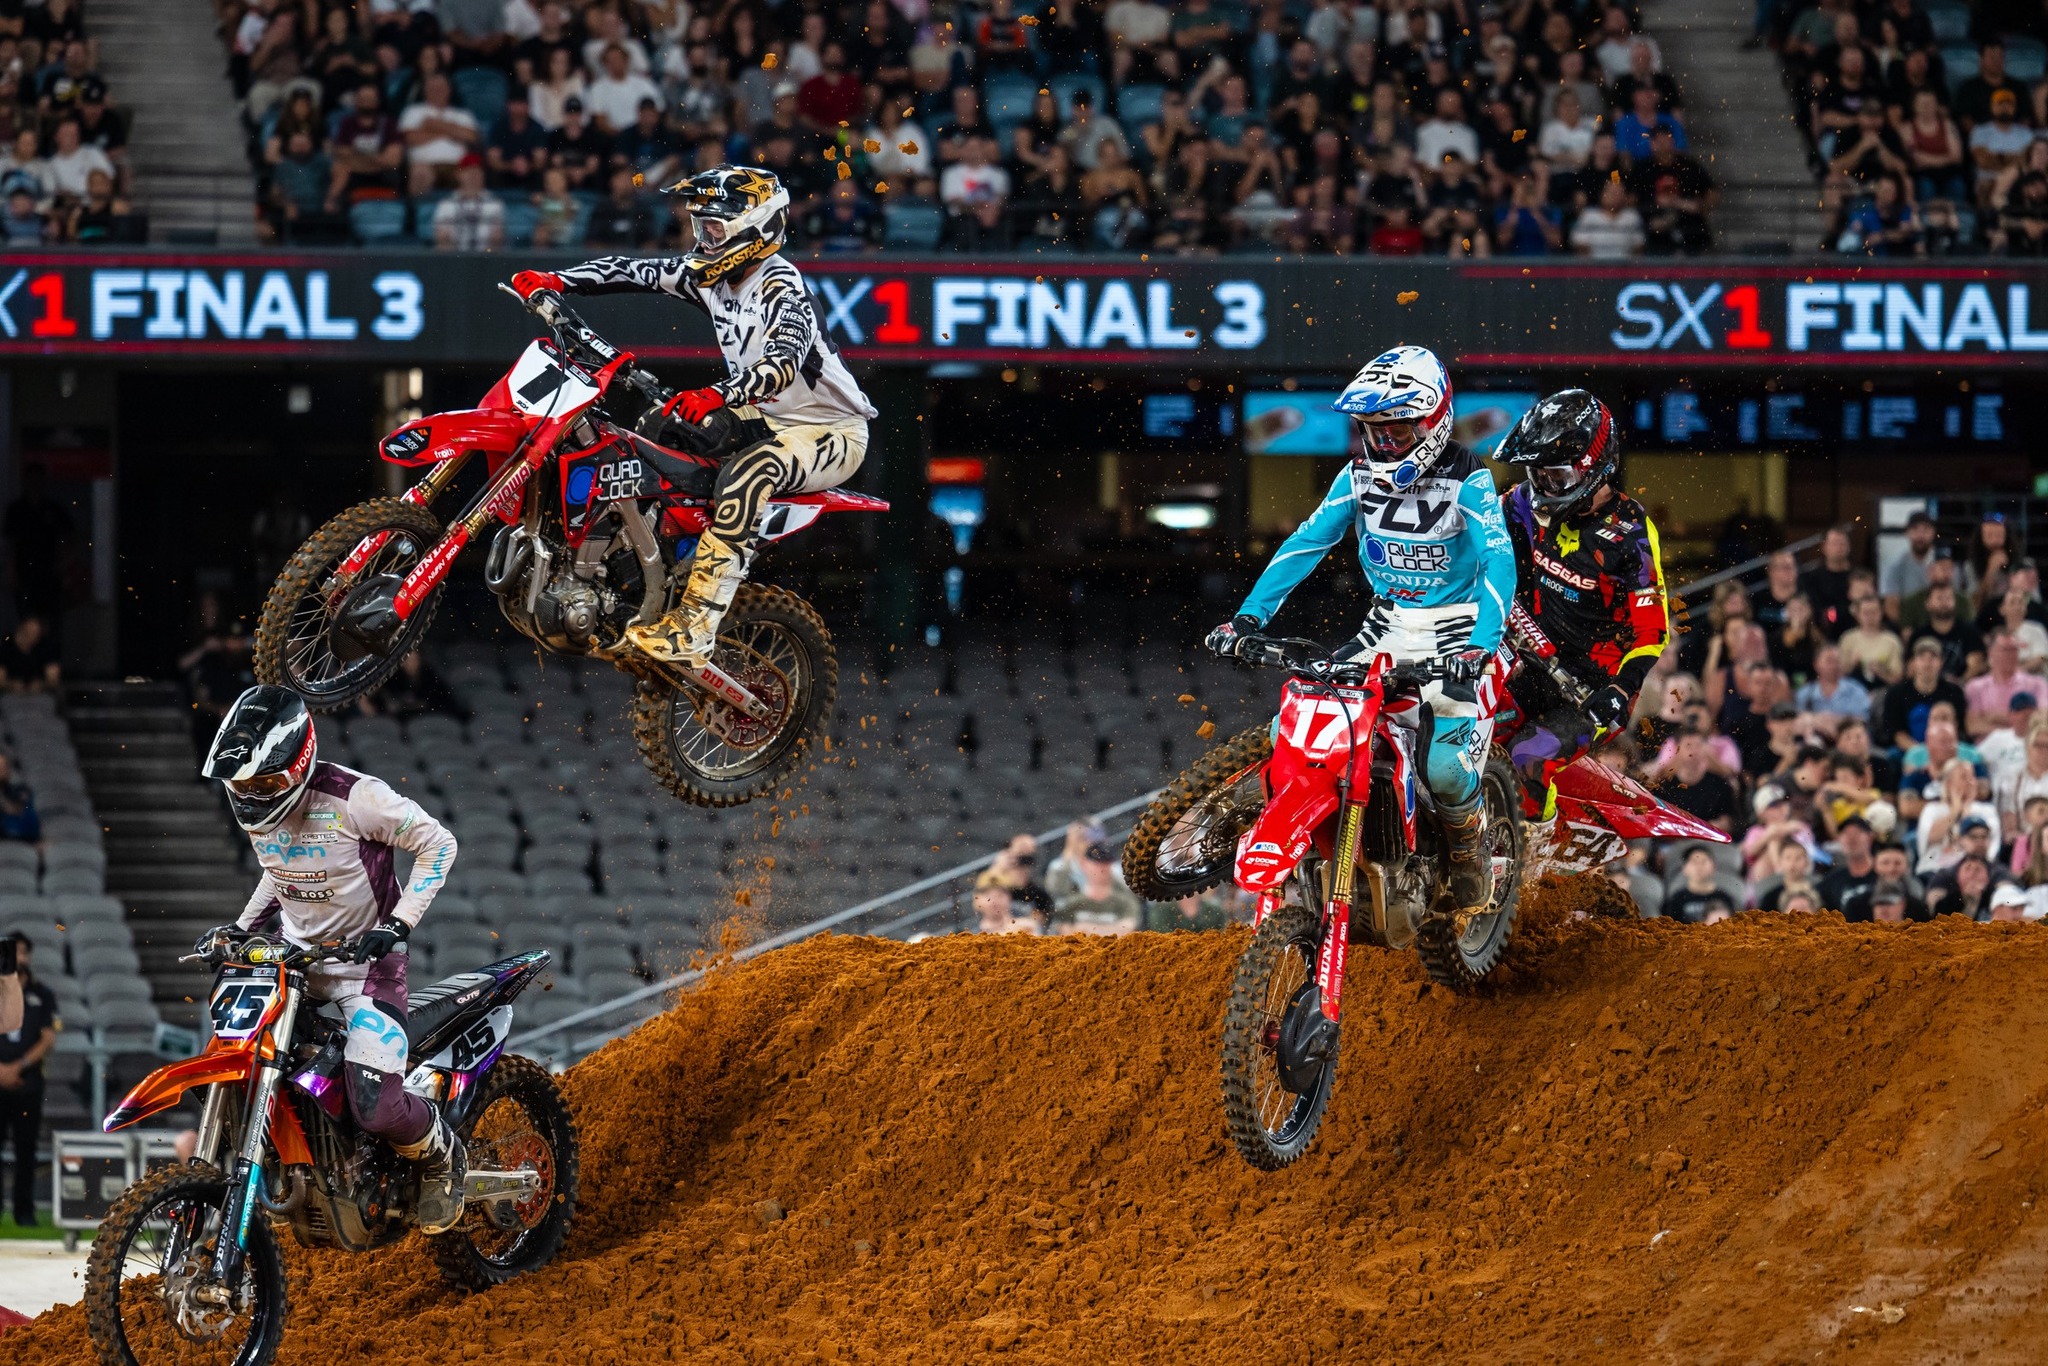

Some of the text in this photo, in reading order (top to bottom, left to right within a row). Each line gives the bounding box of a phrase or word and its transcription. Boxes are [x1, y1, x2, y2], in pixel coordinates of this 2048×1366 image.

[705, 238, 765, 279] ROCKSTAR
[0, 269, 425, 341] 1 FINAL 3
[781, 309, 805, 324] HGS
[932, 279, 1200, 349] FINAL
[1213, 280, 1267, 349] 3
[1610, 282, 2048, 351] SX1 FINAL
[517, 362, 572, 406] 1
[1393, 408, 1414, 418] froth
[1575, 405, 1592, 426] pod
[434, 447, 456, 459] froth
[600, 459, 643, 483] QUAD
[812, 432, 848, 473] FLY
[1510, 450, 1540, 463] pod
[486, 464, 532, 520] SHOWA
[597, 478, 643, 502] LOCK
[1361, 492, 1452, 534] FLY
[1387, 542, 1446, 559] QUAD
[1389, 555, 1449, 572] LOCK
[1533, 549, 1597, 590] GASGAS
[1546, 577, 1579, 600] ROOFTEK
[1290, 699, 1364, 751] 17
[1289, 841, 1308, 860] froth
[1341, 804, 1359, 879] connection
[210, 984, 277, 1031] 45
[456, 989, 481, 1005] GUTS
[452, 1017, 497, 1071] 45
